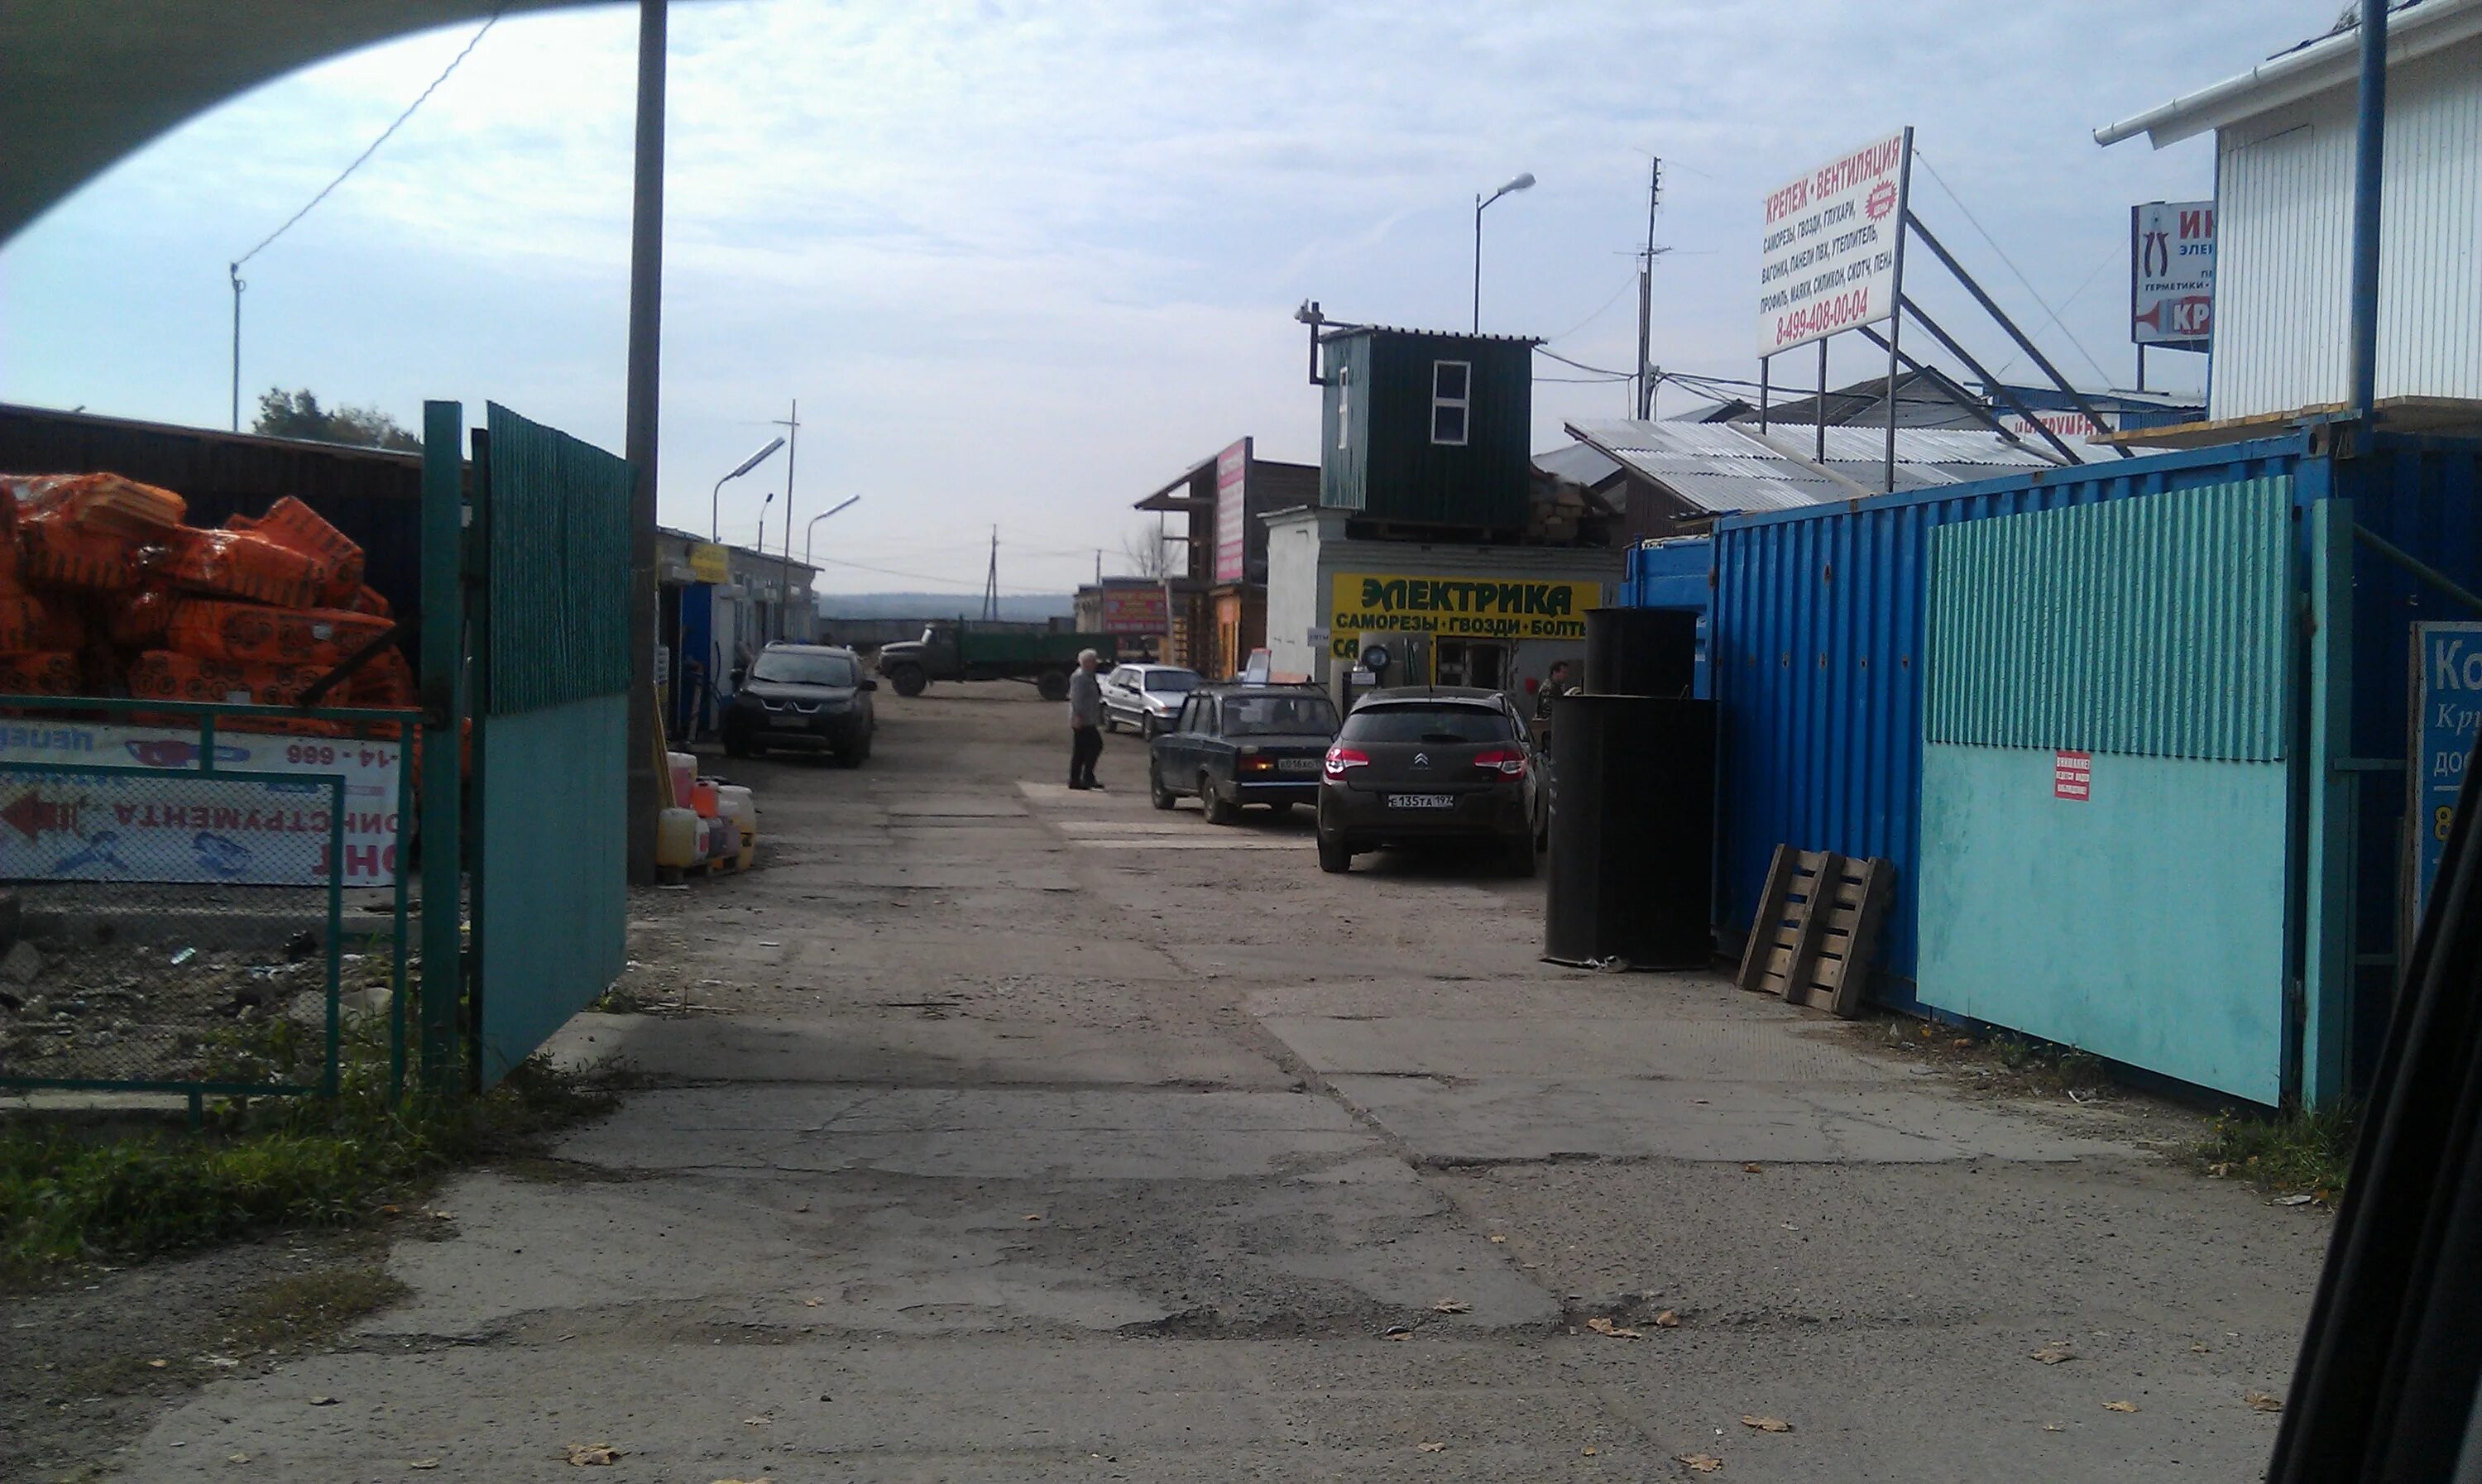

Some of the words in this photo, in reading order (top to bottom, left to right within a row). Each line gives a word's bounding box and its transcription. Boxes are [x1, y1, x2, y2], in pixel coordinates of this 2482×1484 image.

[1766, 178, 1809, 225] КРЕПЕЖ
[1816, 136, 1900, 201] ВЕНТИЛЯЦИЯ
[1873, 249, 1892, 274] ПЕНА
[2145, 280, 2203, 291] ГЕРМЕТИКИ
[1361, 577, 1573, 619] ЭЛЕКТРИКА
[1336, 613, 1438, 631] САМОРЕЗЫ
[1449, 616, 1521, 637] ГВОЗДИ
